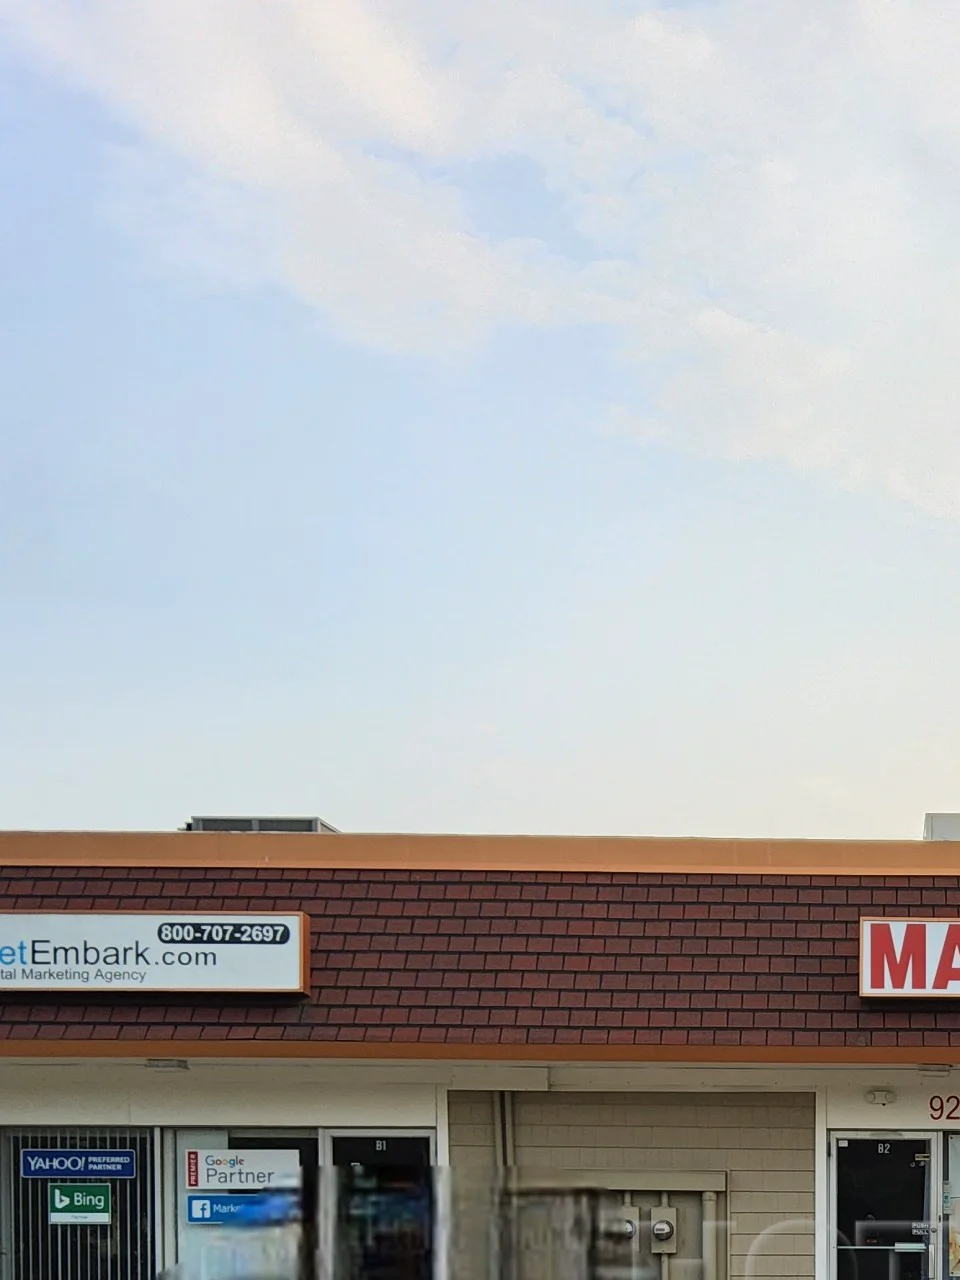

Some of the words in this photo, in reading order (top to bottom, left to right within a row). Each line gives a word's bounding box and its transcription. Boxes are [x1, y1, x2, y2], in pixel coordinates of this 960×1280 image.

[160, 925, 285, 942] 800-707-2697
[21, 969, 90, 984] Marketing
[94, 969, 147, 984] Agency
[877, 1143, 891, 1154] B2
[27, 1156, 86, 1172] YAHOO!
[88, 1156, 130, 1164] PREFERRED
[190, 1153, 198, 1185] PREMIER
[205, 1155, 245, 1168] Google
[206, 1168, 275, 1184] Partner
[74, 1192, 104, 1210] Bing
